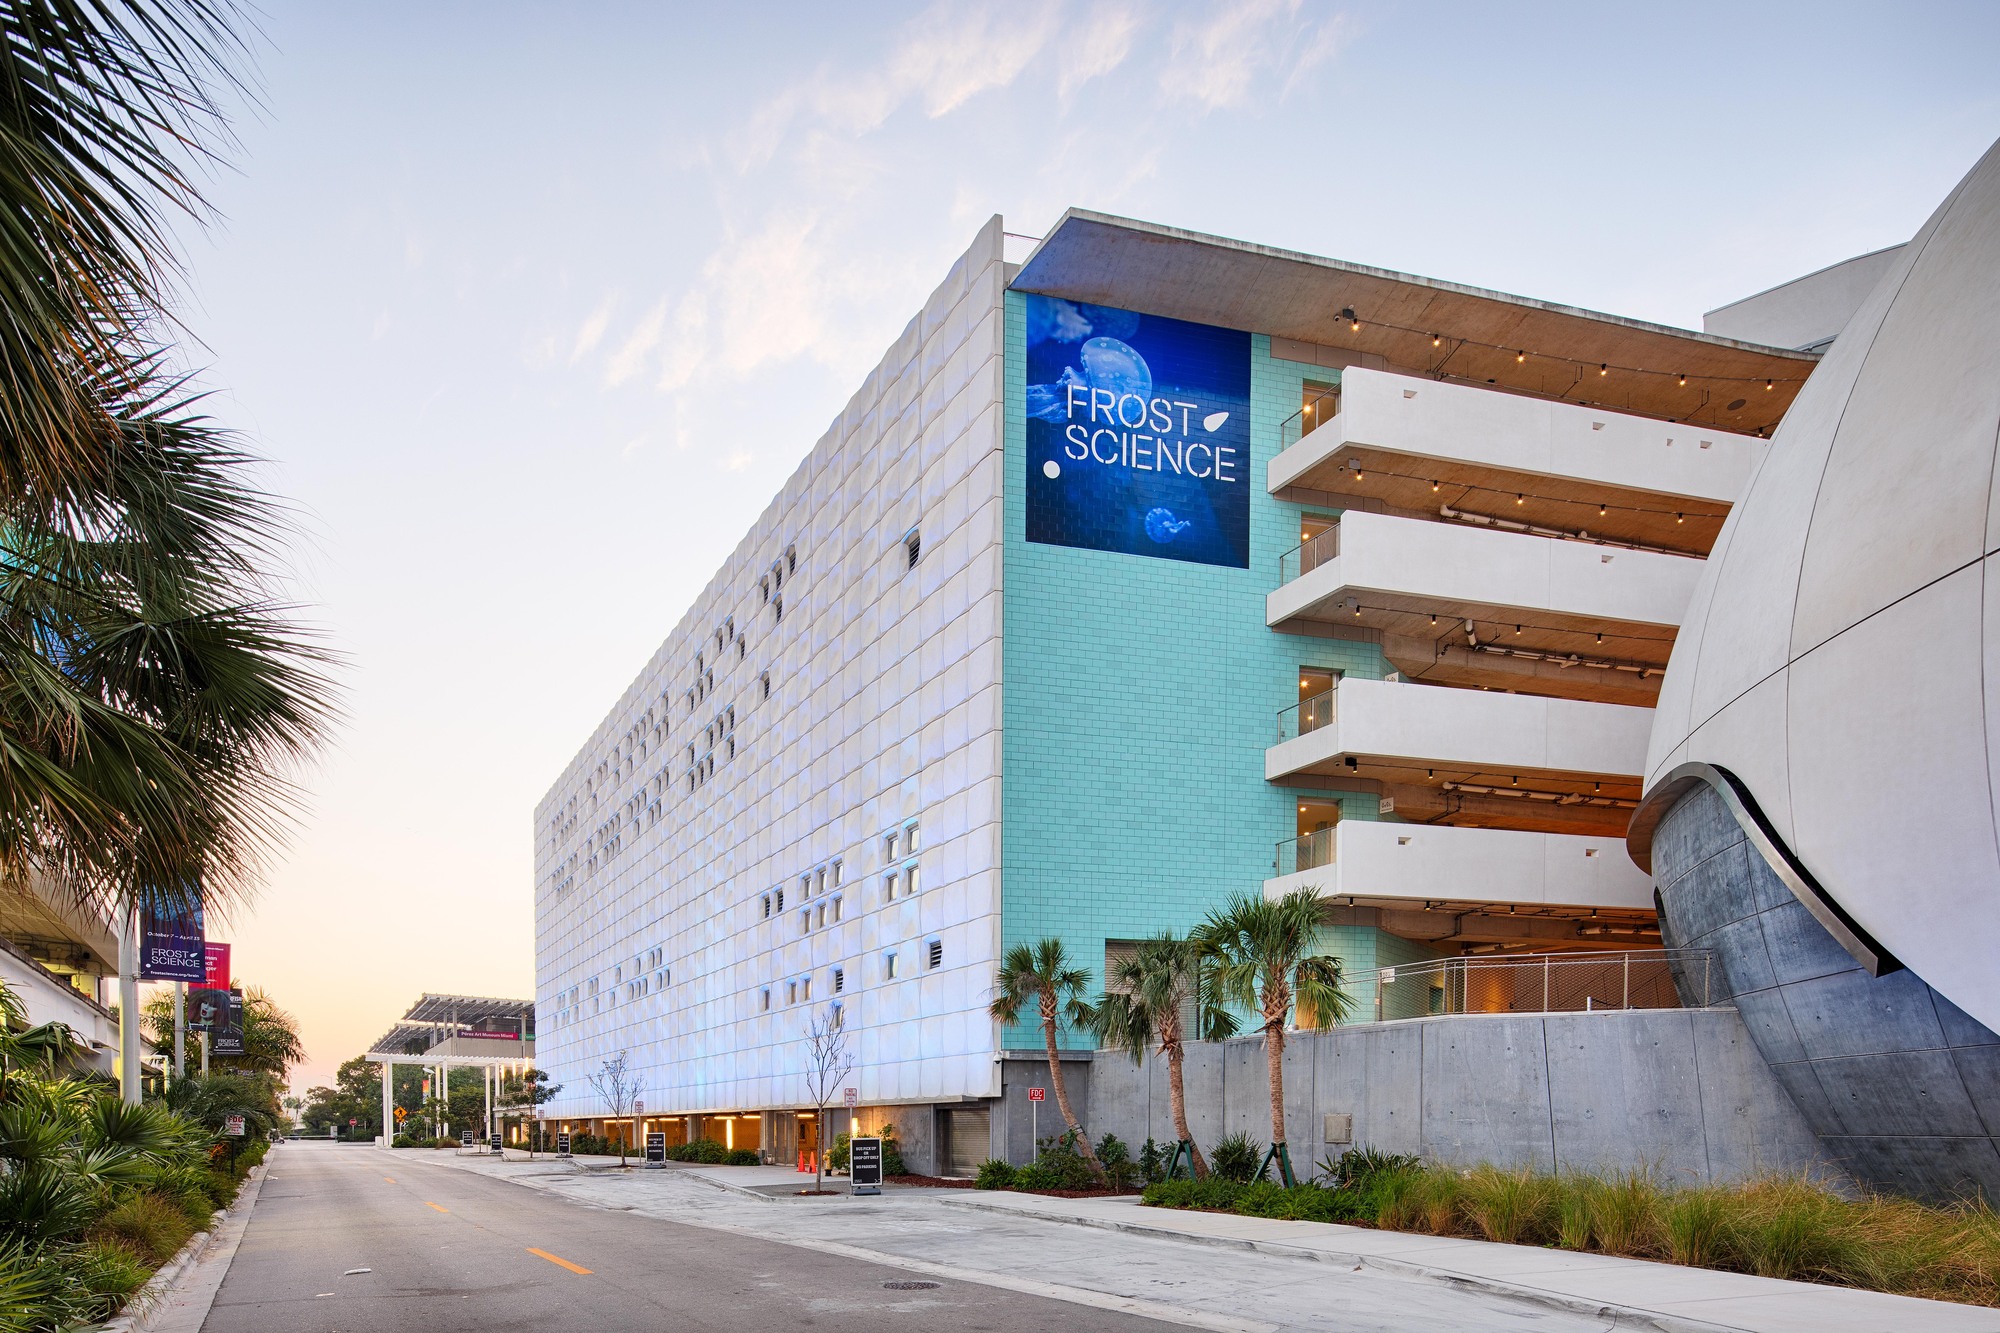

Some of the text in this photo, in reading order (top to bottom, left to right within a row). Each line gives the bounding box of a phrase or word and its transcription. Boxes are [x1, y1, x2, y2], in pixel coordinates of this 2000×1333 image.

[1067, 384, 1197, 436] FROST
[1065, 425, 1235, 482] SCIENCE
[151, 948, 189, 959] FROST
[151, 955, 200, 968] SCIENCE
